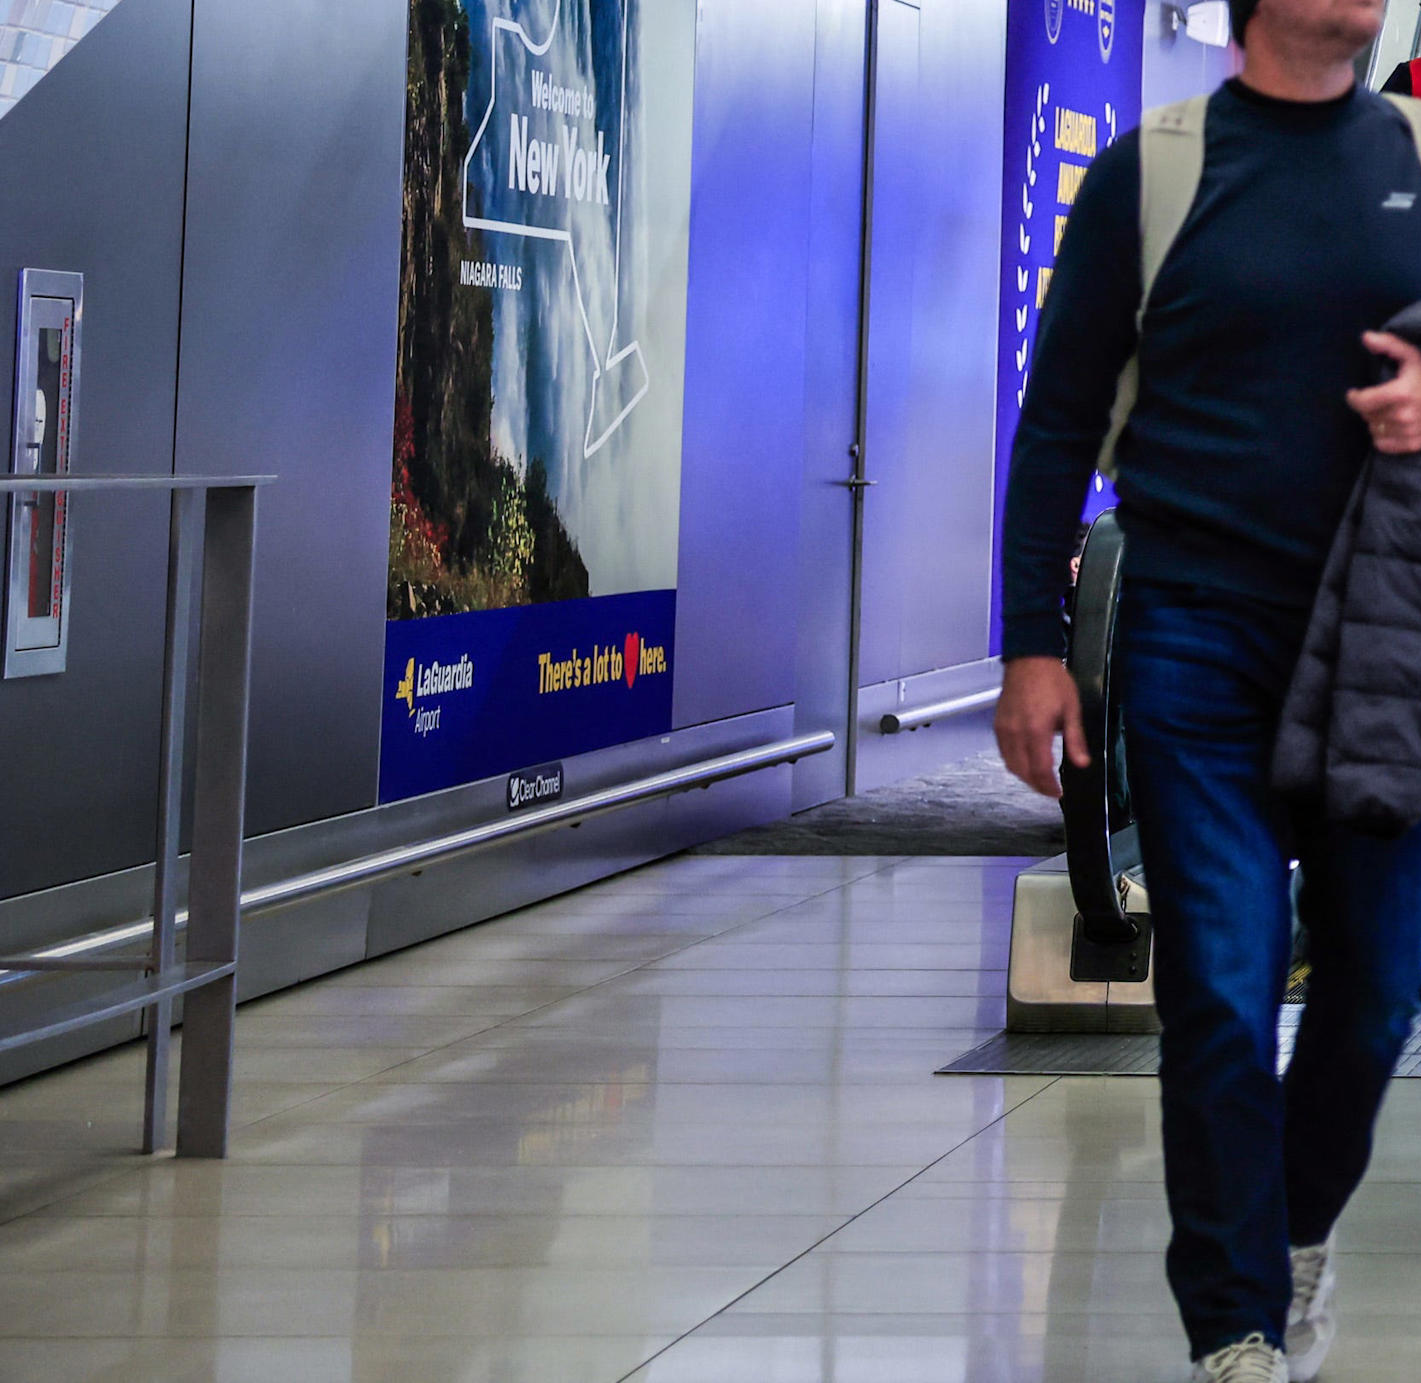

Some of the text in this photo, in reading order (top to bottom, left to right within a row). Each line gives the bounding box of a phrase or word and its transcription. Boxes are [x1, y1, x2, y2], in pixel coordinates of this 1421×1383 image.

[531, 69, 595, 120] Welcome to
[508, 112, 611, 205] New York
[459, 259, 523, 291] NIAGARA FALLS
[416, 653, 474, 698] LaGuardia
[538, 637, 667, 695] There's a lot to here.
[414, 705, 441, 738] Airport
[519, 770, 560, 802] Clear Channel
